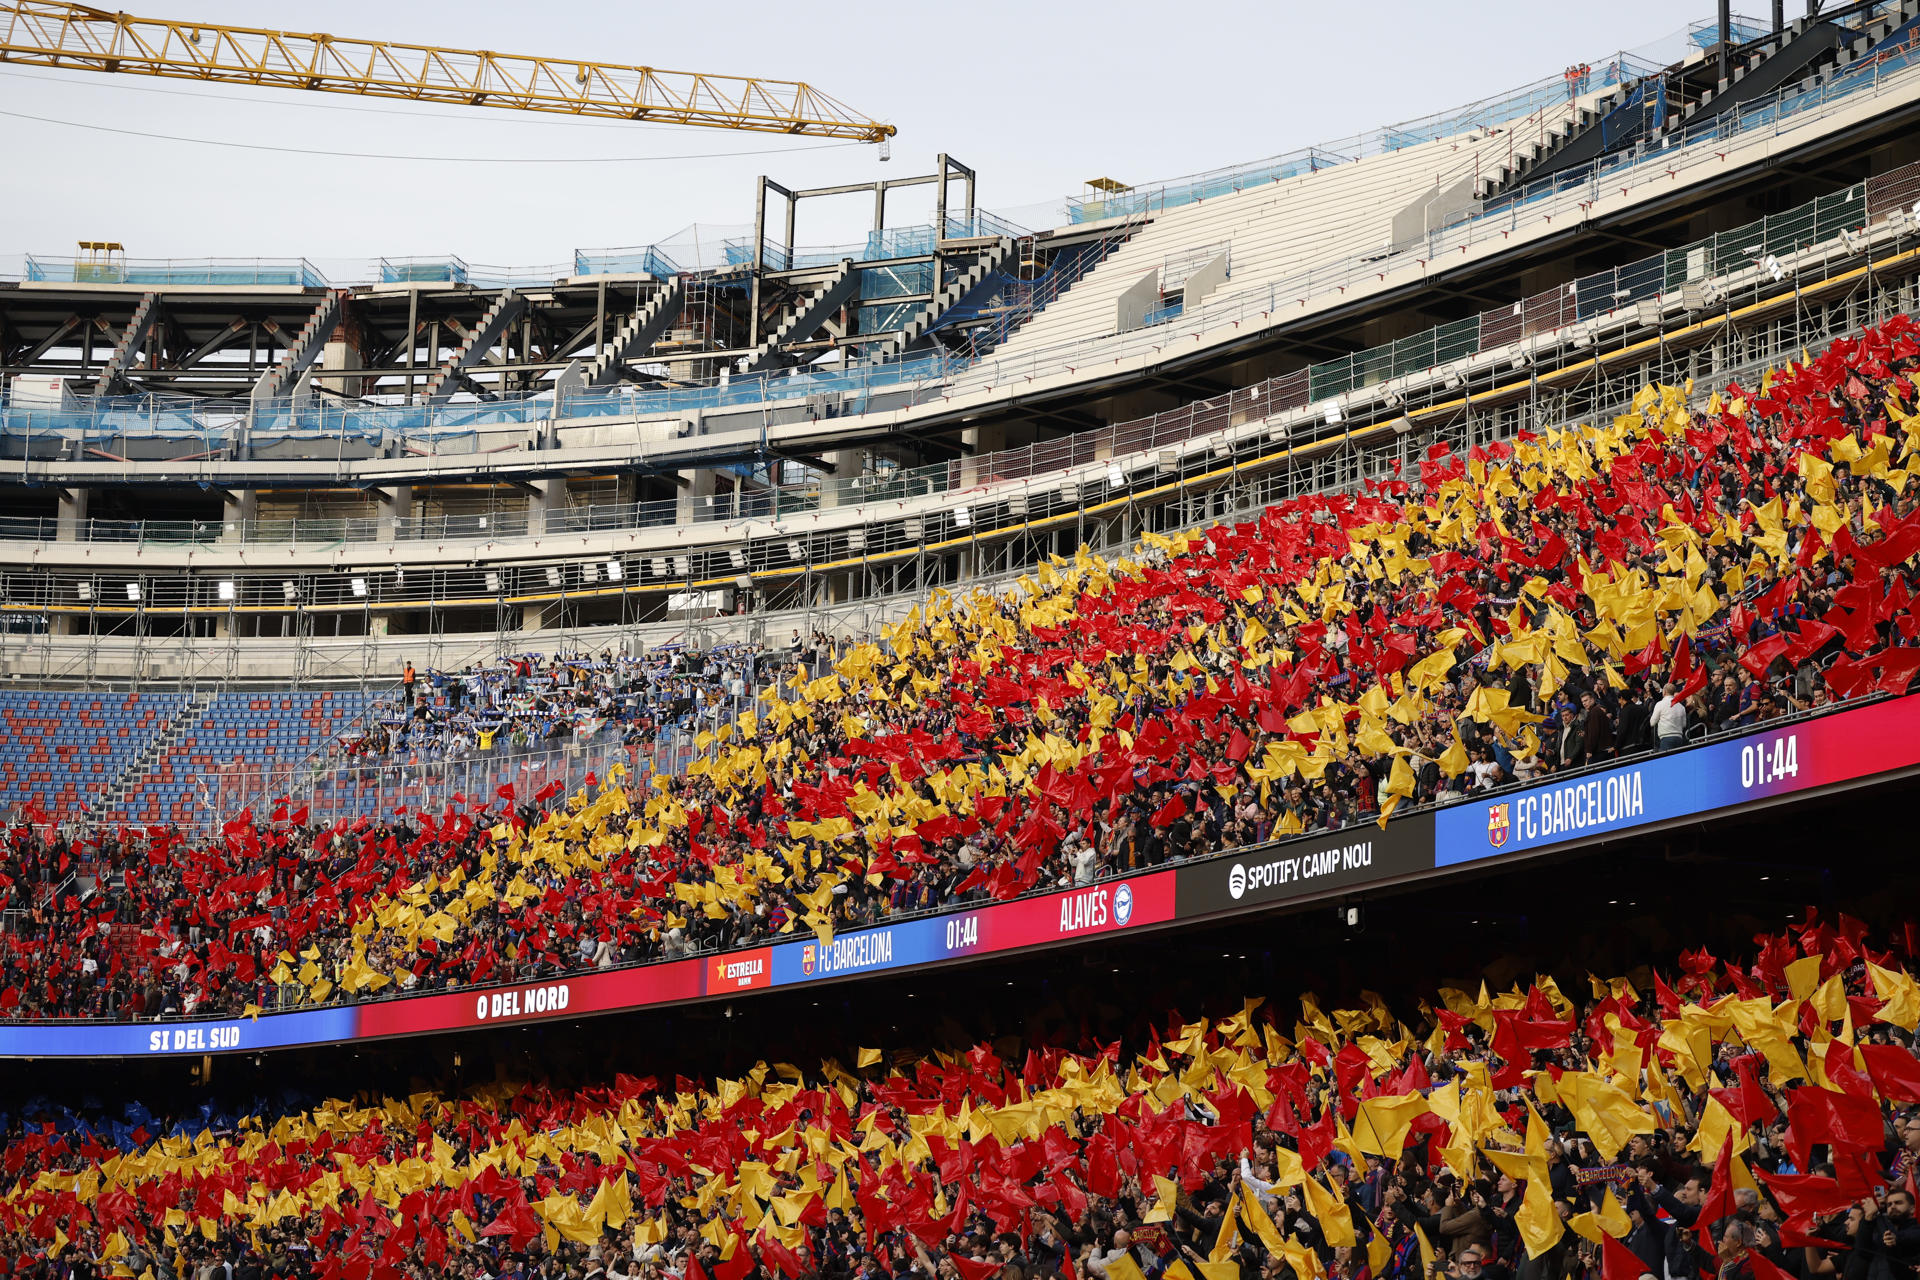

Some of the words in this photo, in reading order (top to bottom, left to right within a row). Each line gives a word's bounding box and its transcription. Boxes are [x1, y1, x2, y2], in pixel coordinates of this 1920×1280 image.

[1741, 736, 1798, 788] 01:44
[1517, 796, 1537, 841] FC
[1541, 772, 1643, 836] BARCELONA
[1248, 857, 1300, 890] SPOTIFY
[1302, 849, 1340, 879] CAMP
[1343, 841, 1372, 871] NOU
[1060, 885, 1107, 932] ALAVÉS
[833, 931, 892, 971] BARCELONA
[946, 917, 978, 950] 01:44
[727, 959, 763, 979] ESTRELLA
[477, 995, 488, 1020] O
[491, 991, 520, 1018] DEL
[524, 985, 569, 1014] NORD
[149, 1030, 170, 1051] SI
[174, 1028, 206, 1050] DEL
[210, 1026, 240, 1049] SUD
